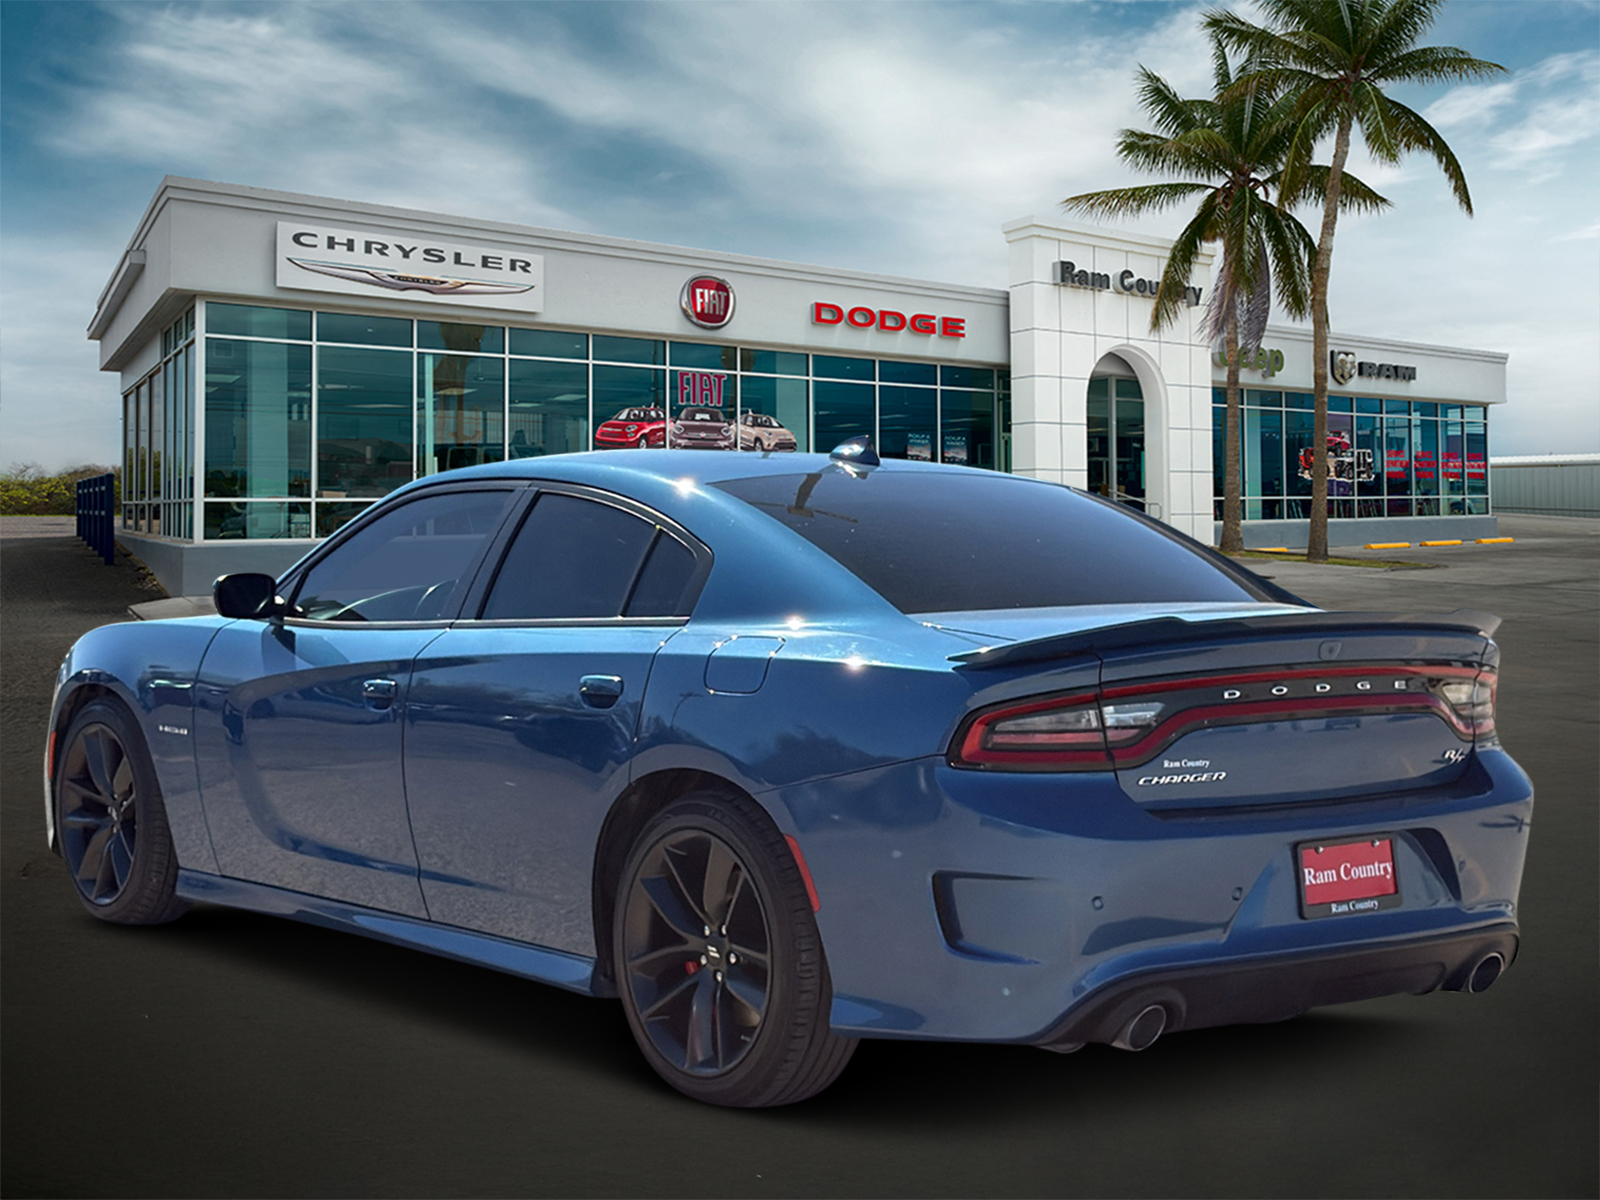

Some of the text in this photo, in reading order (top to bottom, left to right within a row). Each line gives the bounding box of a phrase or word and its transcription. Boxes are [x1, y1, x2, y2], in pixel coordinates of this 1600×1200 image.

[291, 231, 533, 274] CHRYSLER
[1055, 260, 1203, 307] Ram Coury
[694, 287, 728, 316] FIAT
[813, 301, 967, 339] DODGE
[1359, 361, 1417, 381] RAM
[678, 371, 727, 406] FIAT
[1222, 679, 1407, 700] DODGE
[1163, 758, 1211, 769] Ram Country
[1137, 770, 1228, 786] CHARGER
[1303, 860, 1393, 886] Ram Country
[1330, 899, 1379, 914] Ram Country
